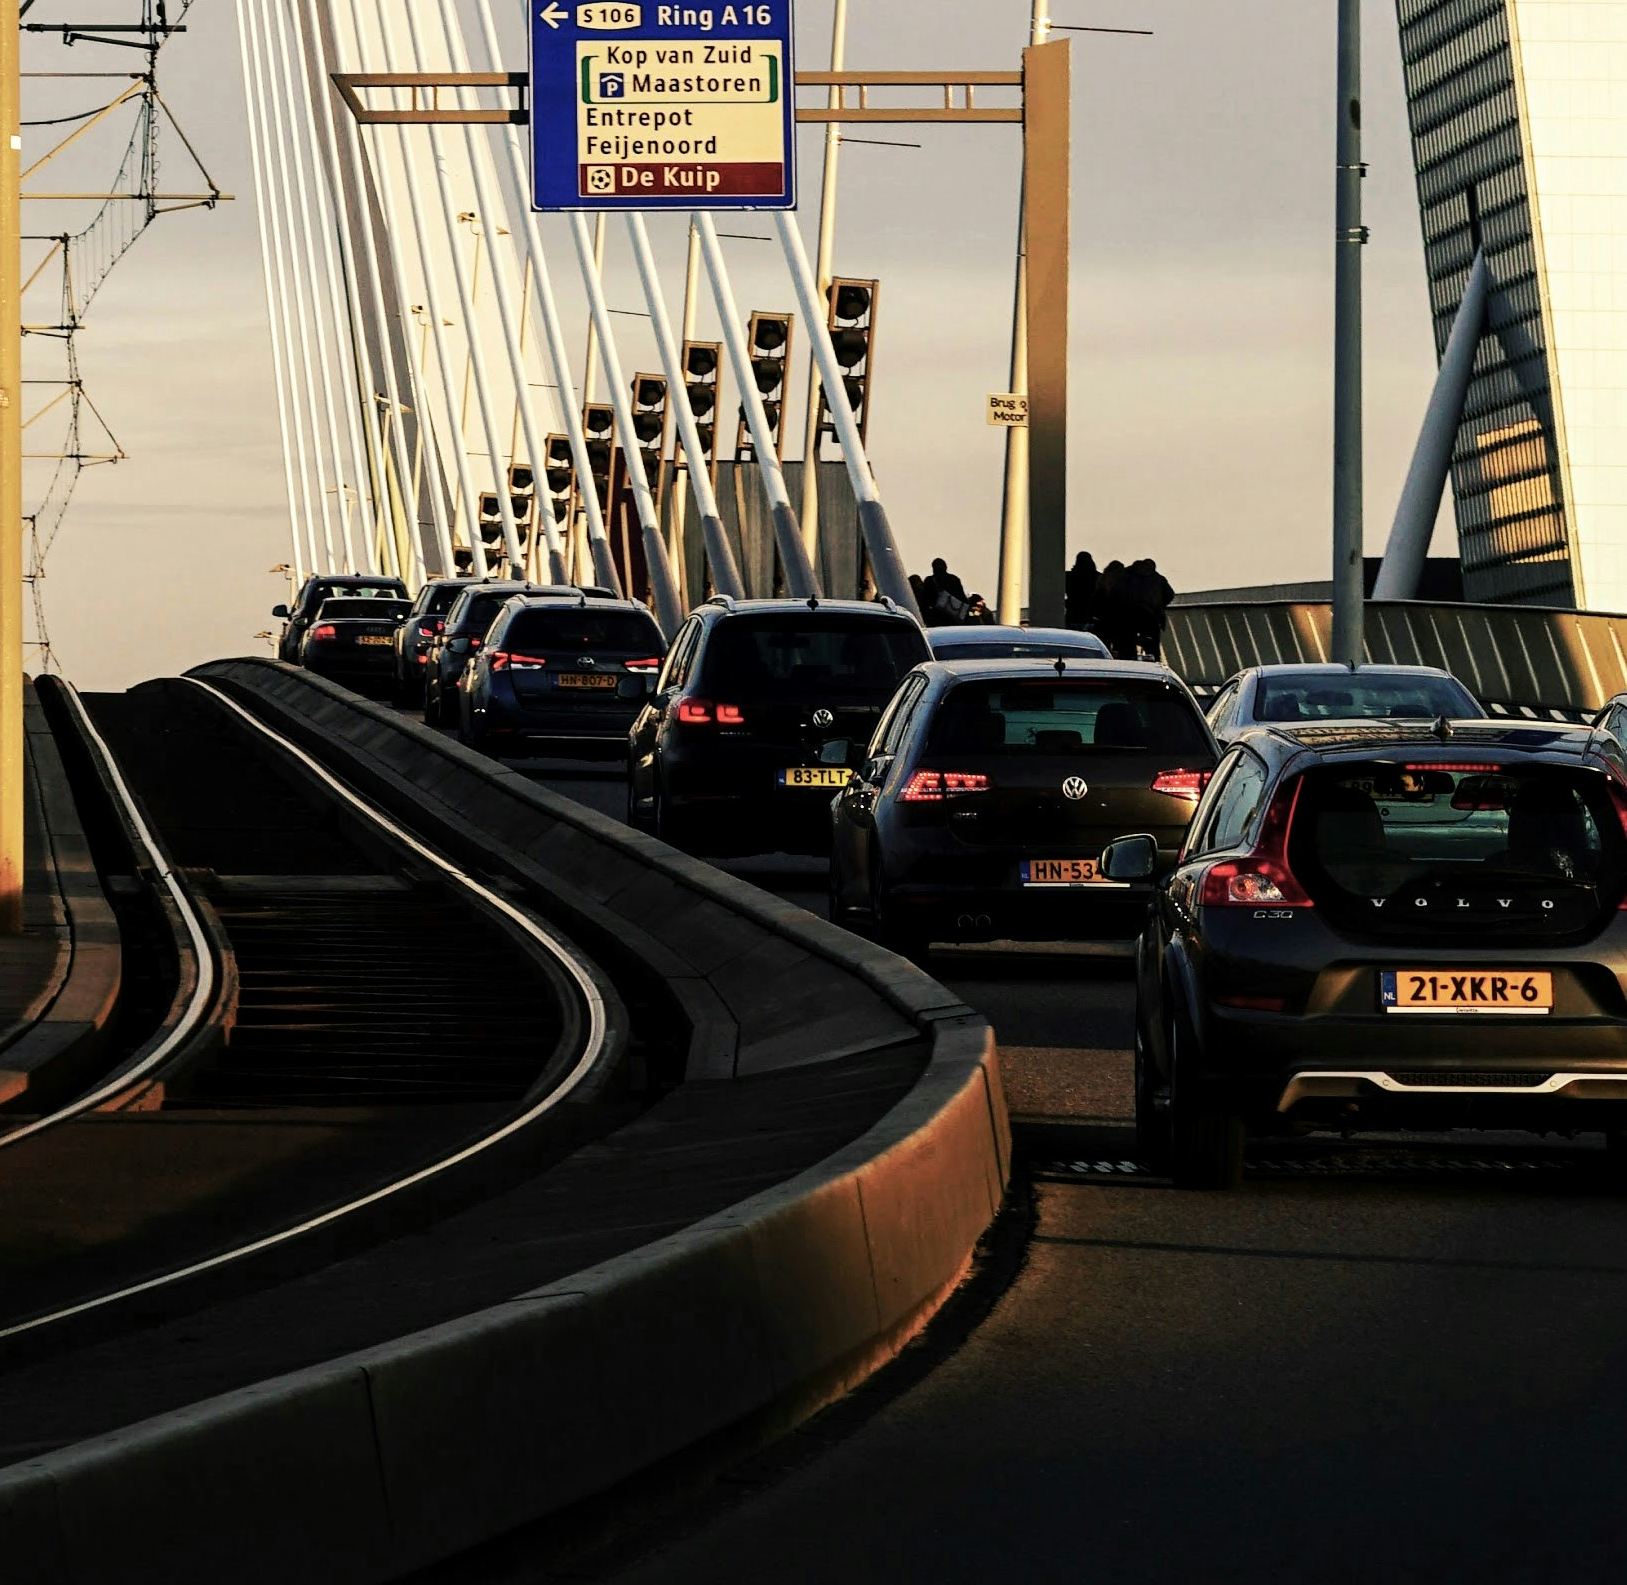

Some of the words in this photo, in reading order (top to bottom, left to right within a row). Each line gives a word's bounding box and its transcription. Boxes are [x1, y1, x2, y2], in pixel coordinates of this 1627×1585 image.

[583, 9, 593, 23] S
[601, 9, 635, 23] 106
[657, 5, 713, 31] Ring
[721, 5, 772, 25] A16
[607, 46, 647, 68] Kop
[656, 50, 693, 64] van
[704, 45, 752, 64] Zuid
[632, 74, 761, 92] Maastoren
[586, 108, 693, 131] Entrepot
[586, 136, 717, 159] Feijenoord
[621, 167, 655, 187] De
[663, 166, 721, 191] Kuip
[990, 397, 1016, 411] Brug
[993, 411, 1027, 422] Motor
[1369, 897, 1554, 909] VOLVO
[1252, 909, 1294, 919] C30
[1383, 992, 1396, 1000] NL
[1409, 976, 1538, 1002] 21-XKR-6
